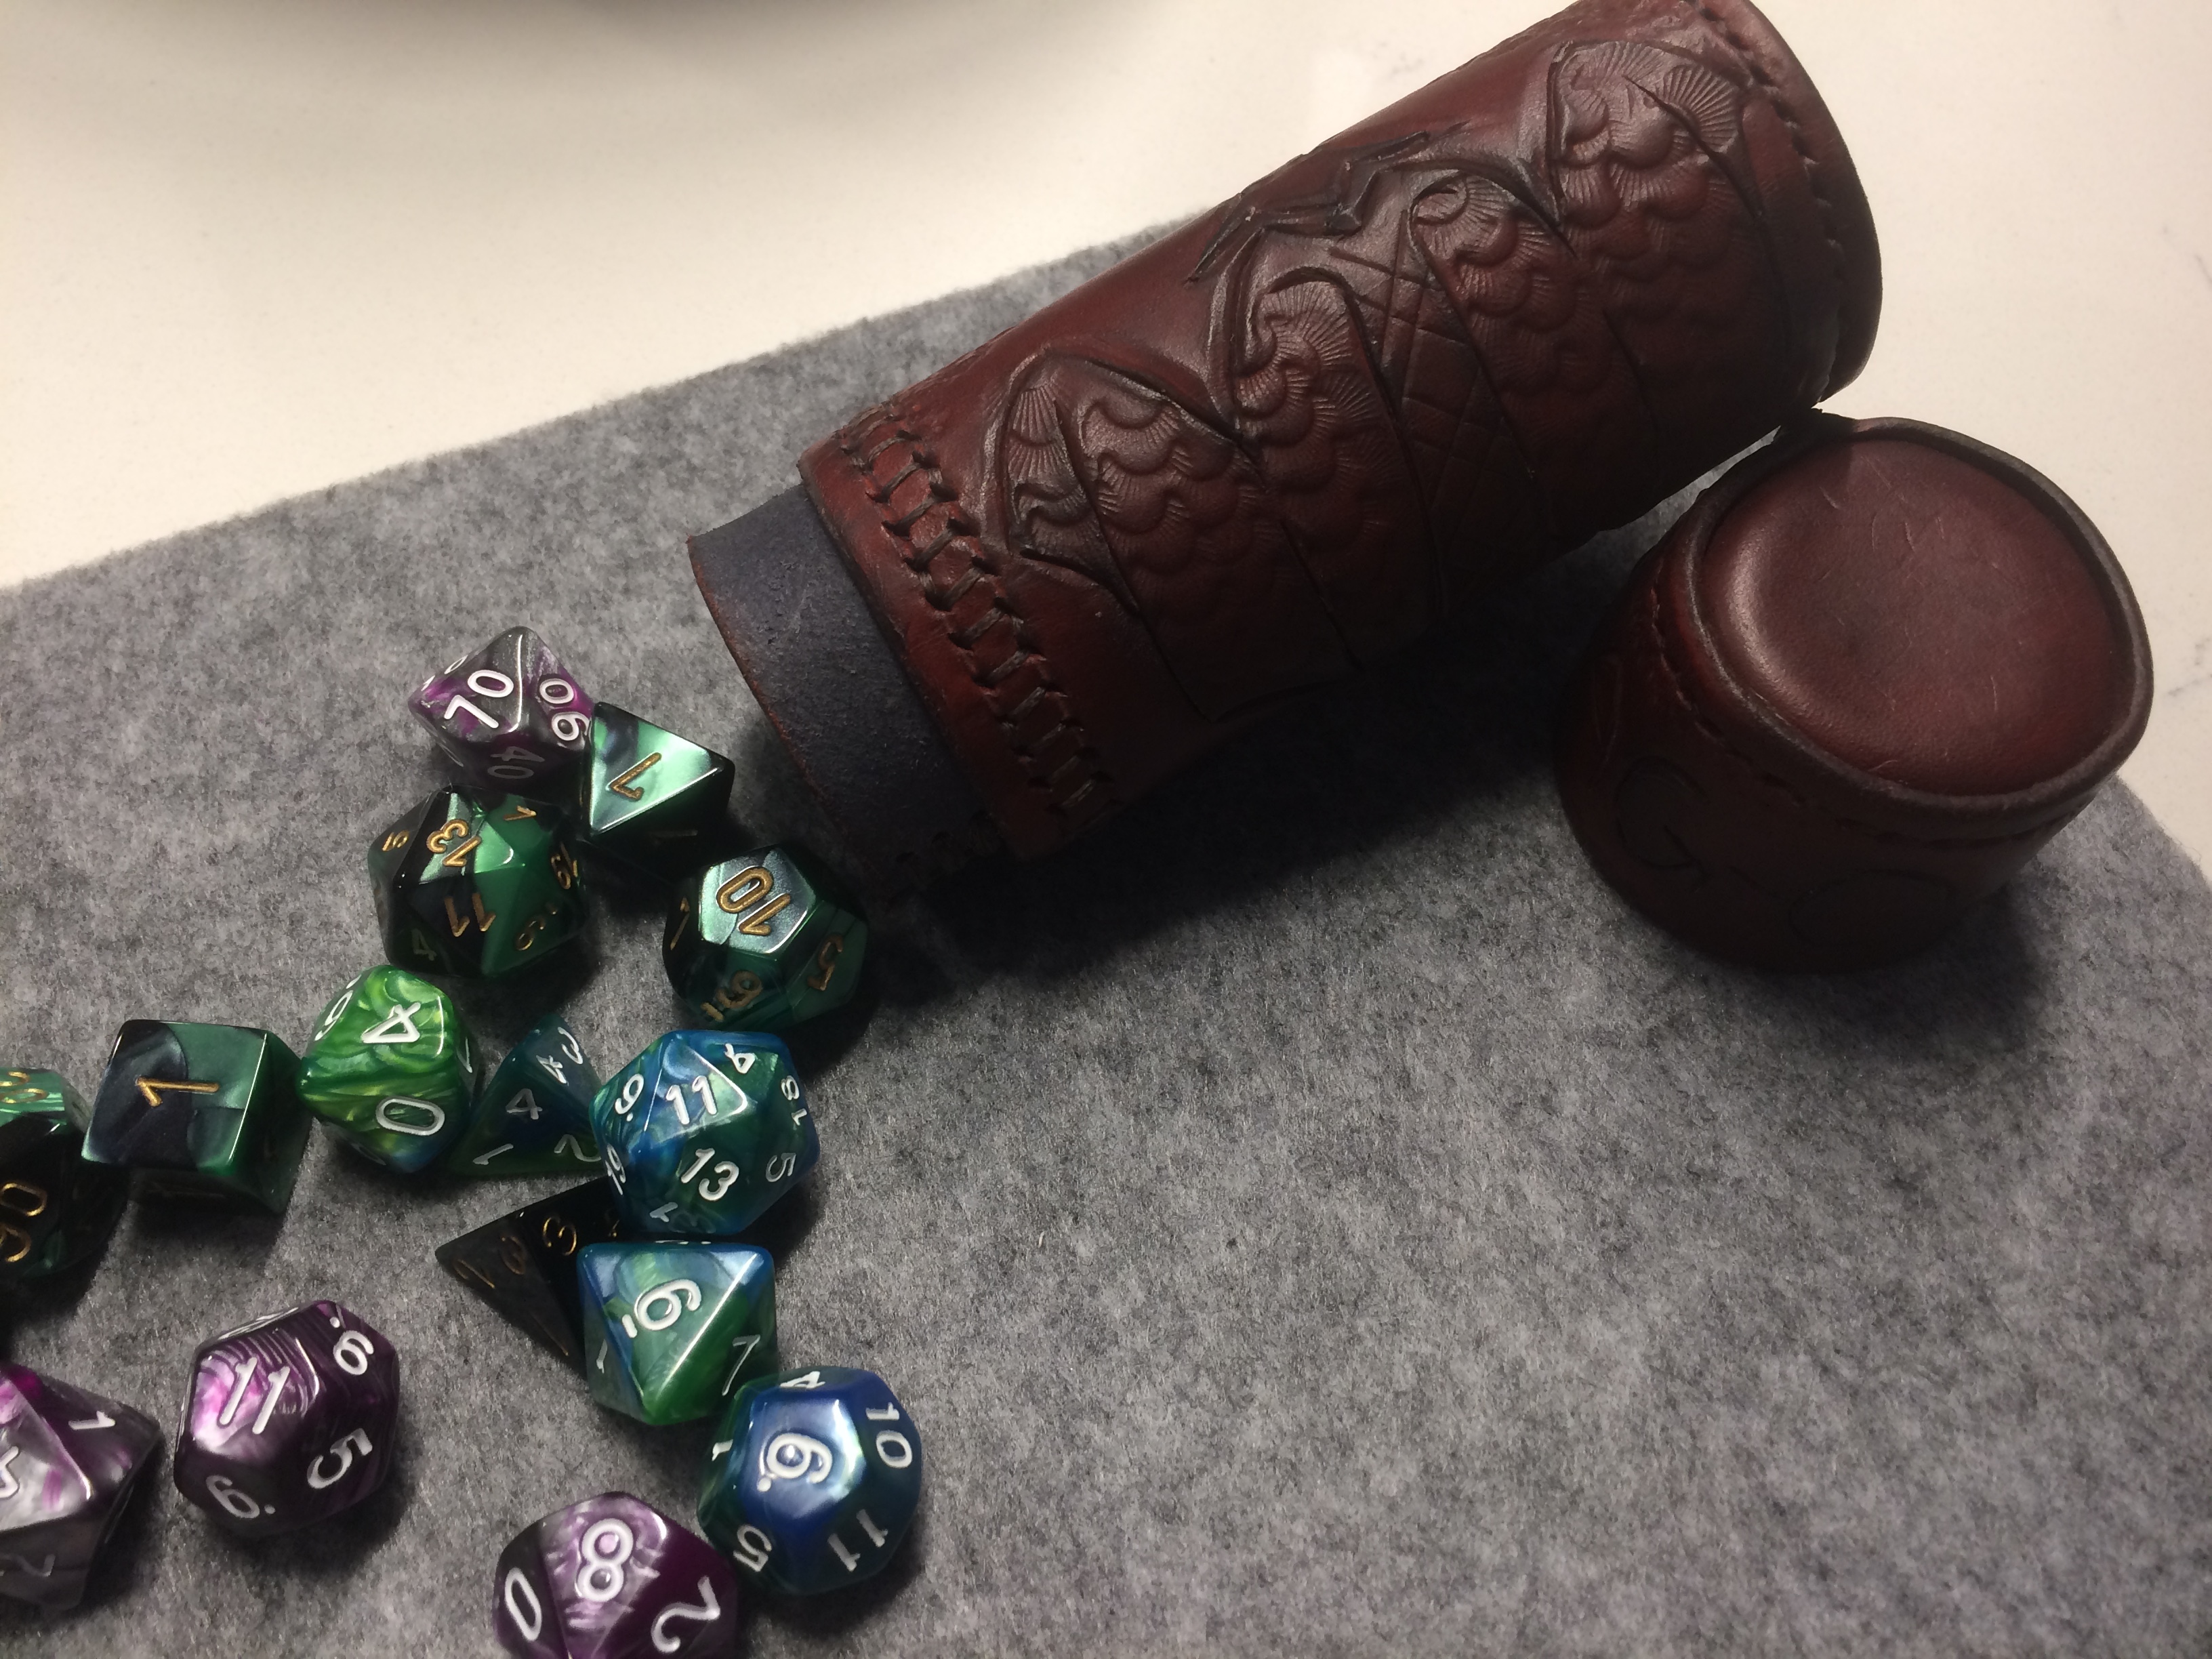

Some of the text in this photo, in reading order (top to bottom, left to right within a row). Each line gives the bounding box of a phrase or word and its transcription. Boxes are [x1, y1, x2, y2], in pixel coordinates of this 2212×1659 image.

[444, 669, 514, 729] 70
[487, 745, 546, 779] 40
[426, 818, 483, 867] 13
[443, 891, 497, 938] 11
[716, 865, 792, 937] 10
[361, 1001, 422, 1044] 4
[723, 1042, 756, 1074] 4
[136, 1076, 221, 1109] 1
[375, 1095, 446, 1136] 0
[505, 1088, 544, 1120] 4
[665, 1074, 718, 1126] 11
[472, 1143, 515, 1166] 1
[680, 1147, 741, 1202] 13
[765, 1151, 797, 1183] 5
[218, 1356, 292, 1435] 11
[779, 1370, 826, 1389] 4
[68, 1410, 116, 1432] 1
[865, 1401, 914, 1469] 10
[306, 1427, 374, 1490] 5
[576, 1517, 634, 1603] 8
[732, 1522, 773, 1574] 5
[826, 1508, 890, 1573] 11
[504, 1566, 542, 1642] 0
[651, 1575, 722, 1655] 2
